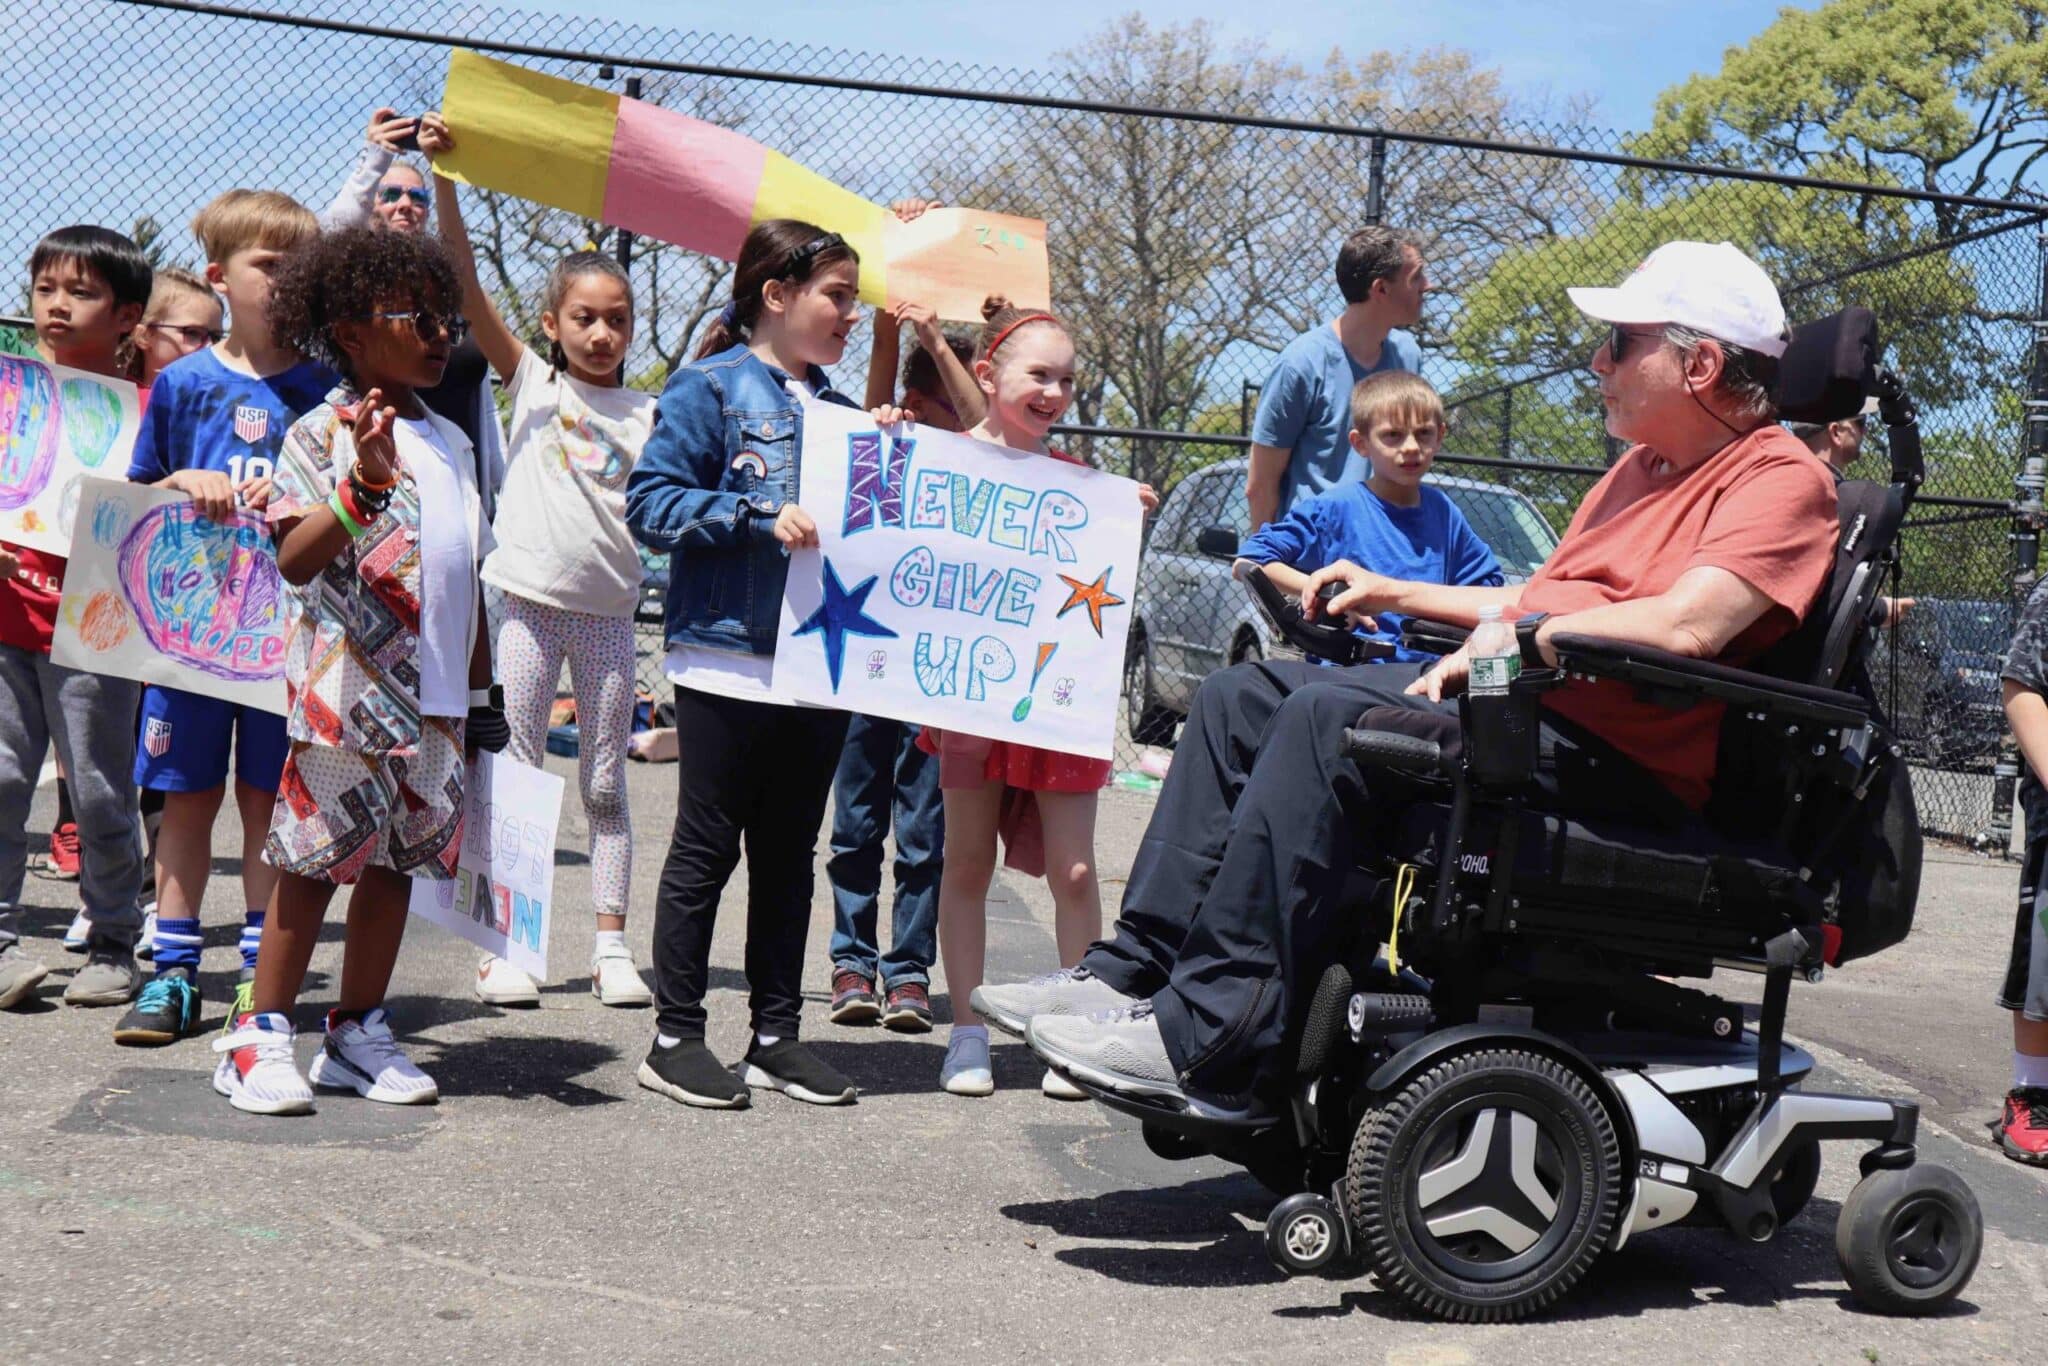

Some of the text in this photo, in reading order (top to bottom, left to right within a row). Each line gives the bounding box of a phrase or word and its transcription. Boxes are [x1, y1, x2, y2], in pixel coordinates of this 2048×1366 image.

[237, 408, 267, 423] USA
[841, 430, 1089, 564] NEVER
[889, 545, 1042, 628] GIVE
[161, 619, 286, 669] Hope
[912, 632, 1060, 723] UP!
[147, 720, 170, 736] USA
[1639, 1158, 1658, 1177] F3
